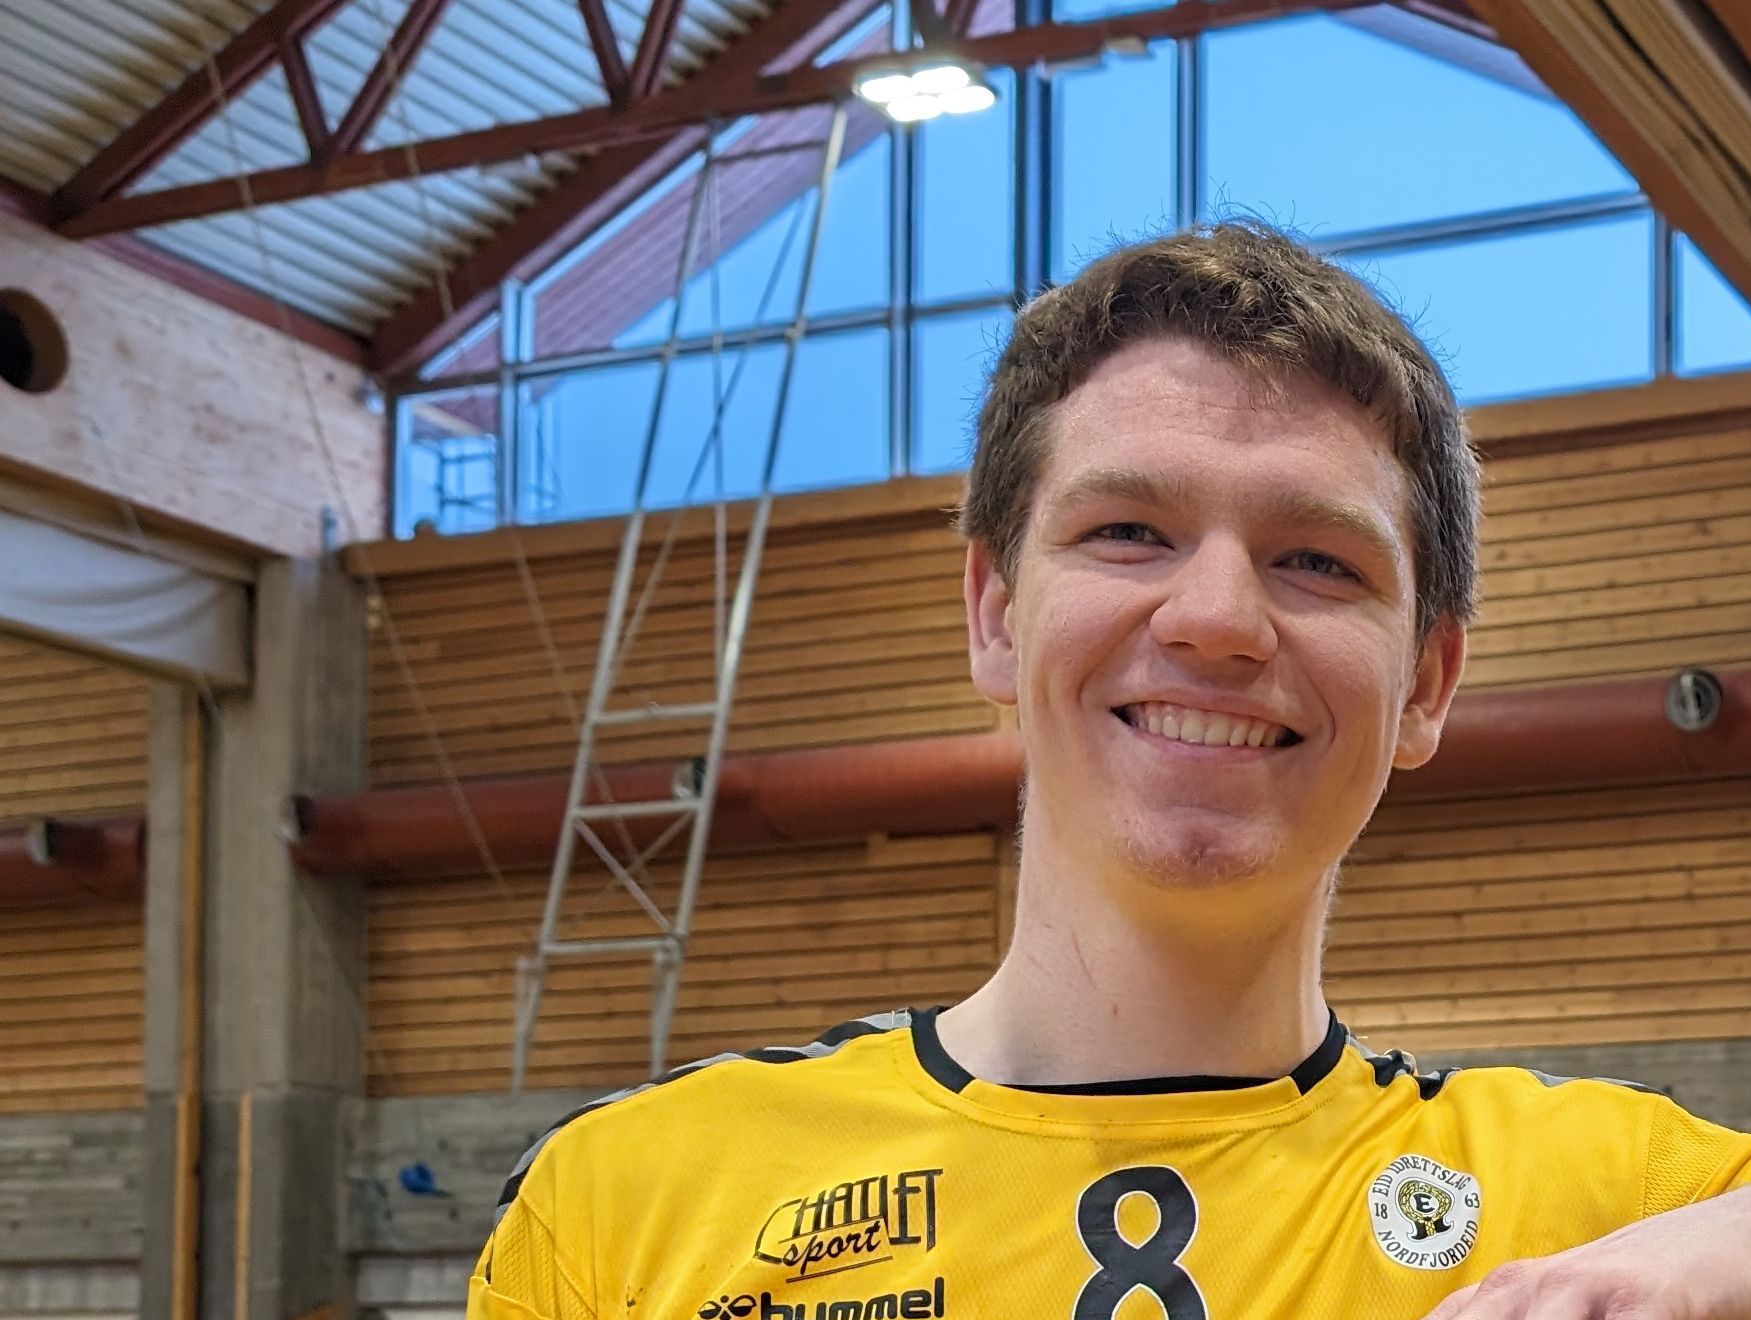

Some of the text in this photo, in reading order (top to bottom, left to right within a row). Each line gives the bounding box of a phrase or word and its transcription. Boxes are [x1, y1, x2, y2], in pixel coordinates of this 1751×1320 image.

[1372, 1156, 1471, 1197] EID IDRETTSLAG
[1374, 1202, 1388, 1219] 18
[1412, 1192, 1435, 1213] E
[1464, 1192, 1480, 1209] 63
[783, 1220, 882, 1275] sport
[1378, 1220, 1479, 1268] NORDFJORDEID
